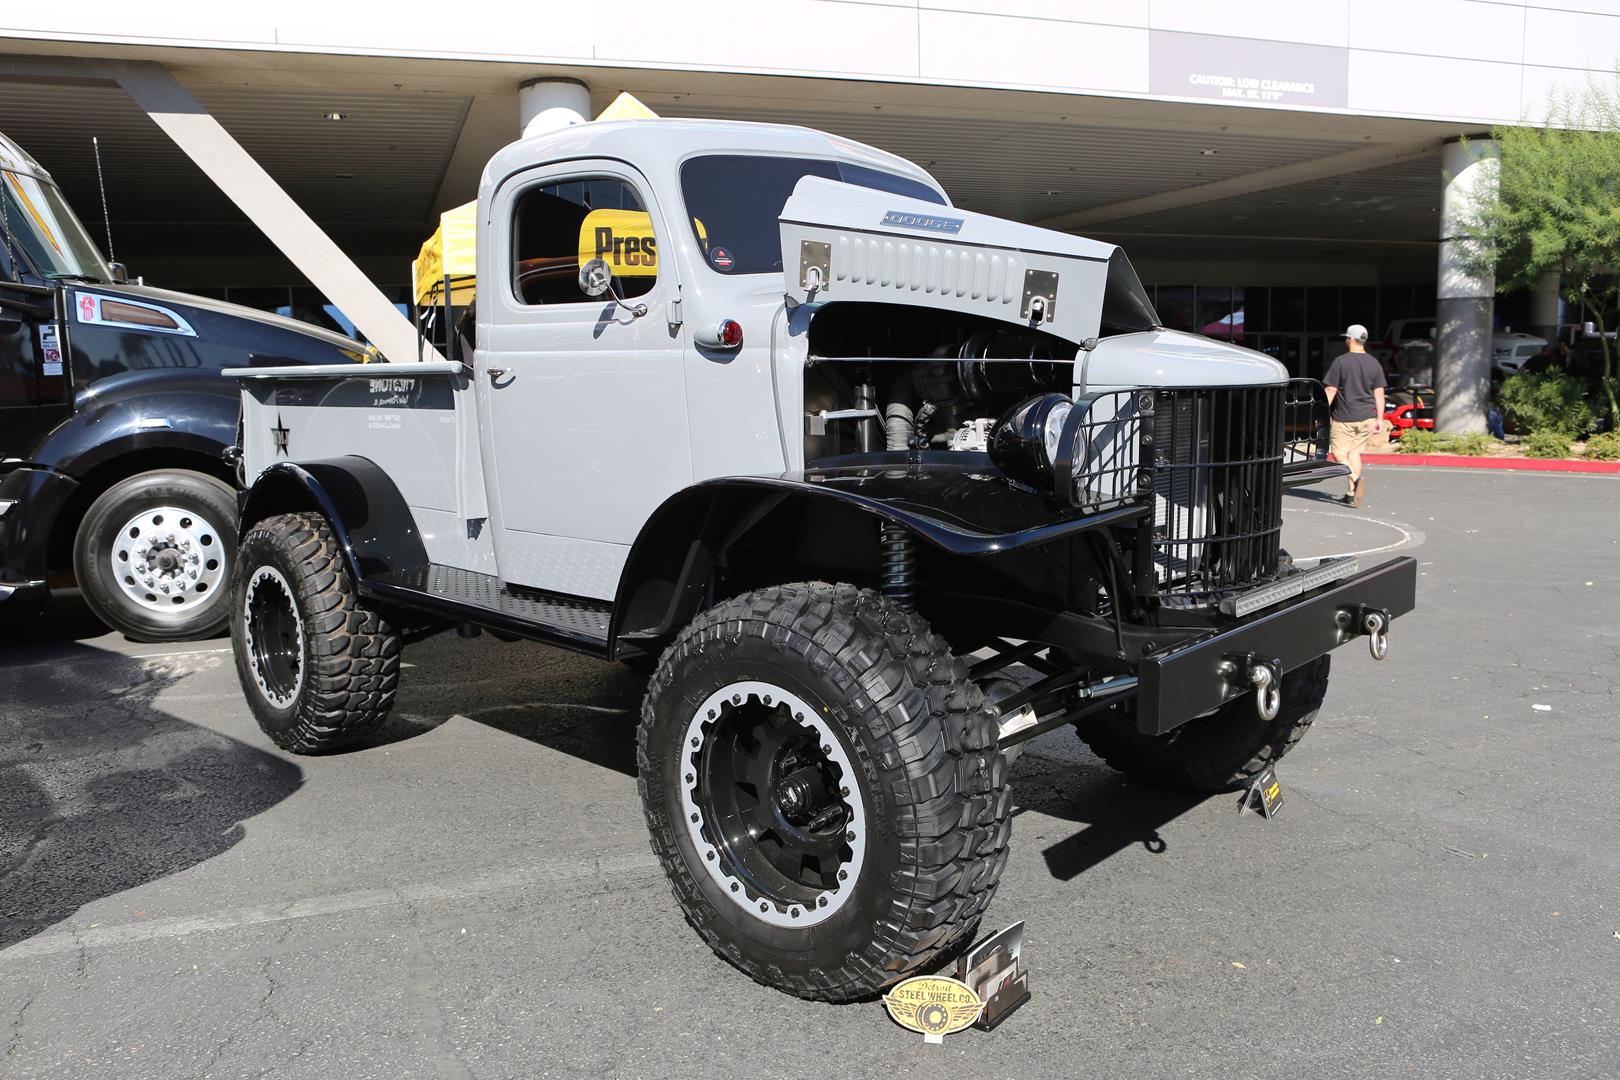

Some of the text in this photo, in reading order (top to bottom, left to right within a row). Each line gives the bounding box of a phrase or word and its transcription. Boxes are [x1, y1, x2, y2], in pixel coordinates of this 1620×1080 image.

[1237, 77, 1260, 89] LOW
[1261, 79, 1315, 94] CLEARANCE
[899, 989, 926, 1002] STEEL
[927, 991, 957, 1003] WHEEL
